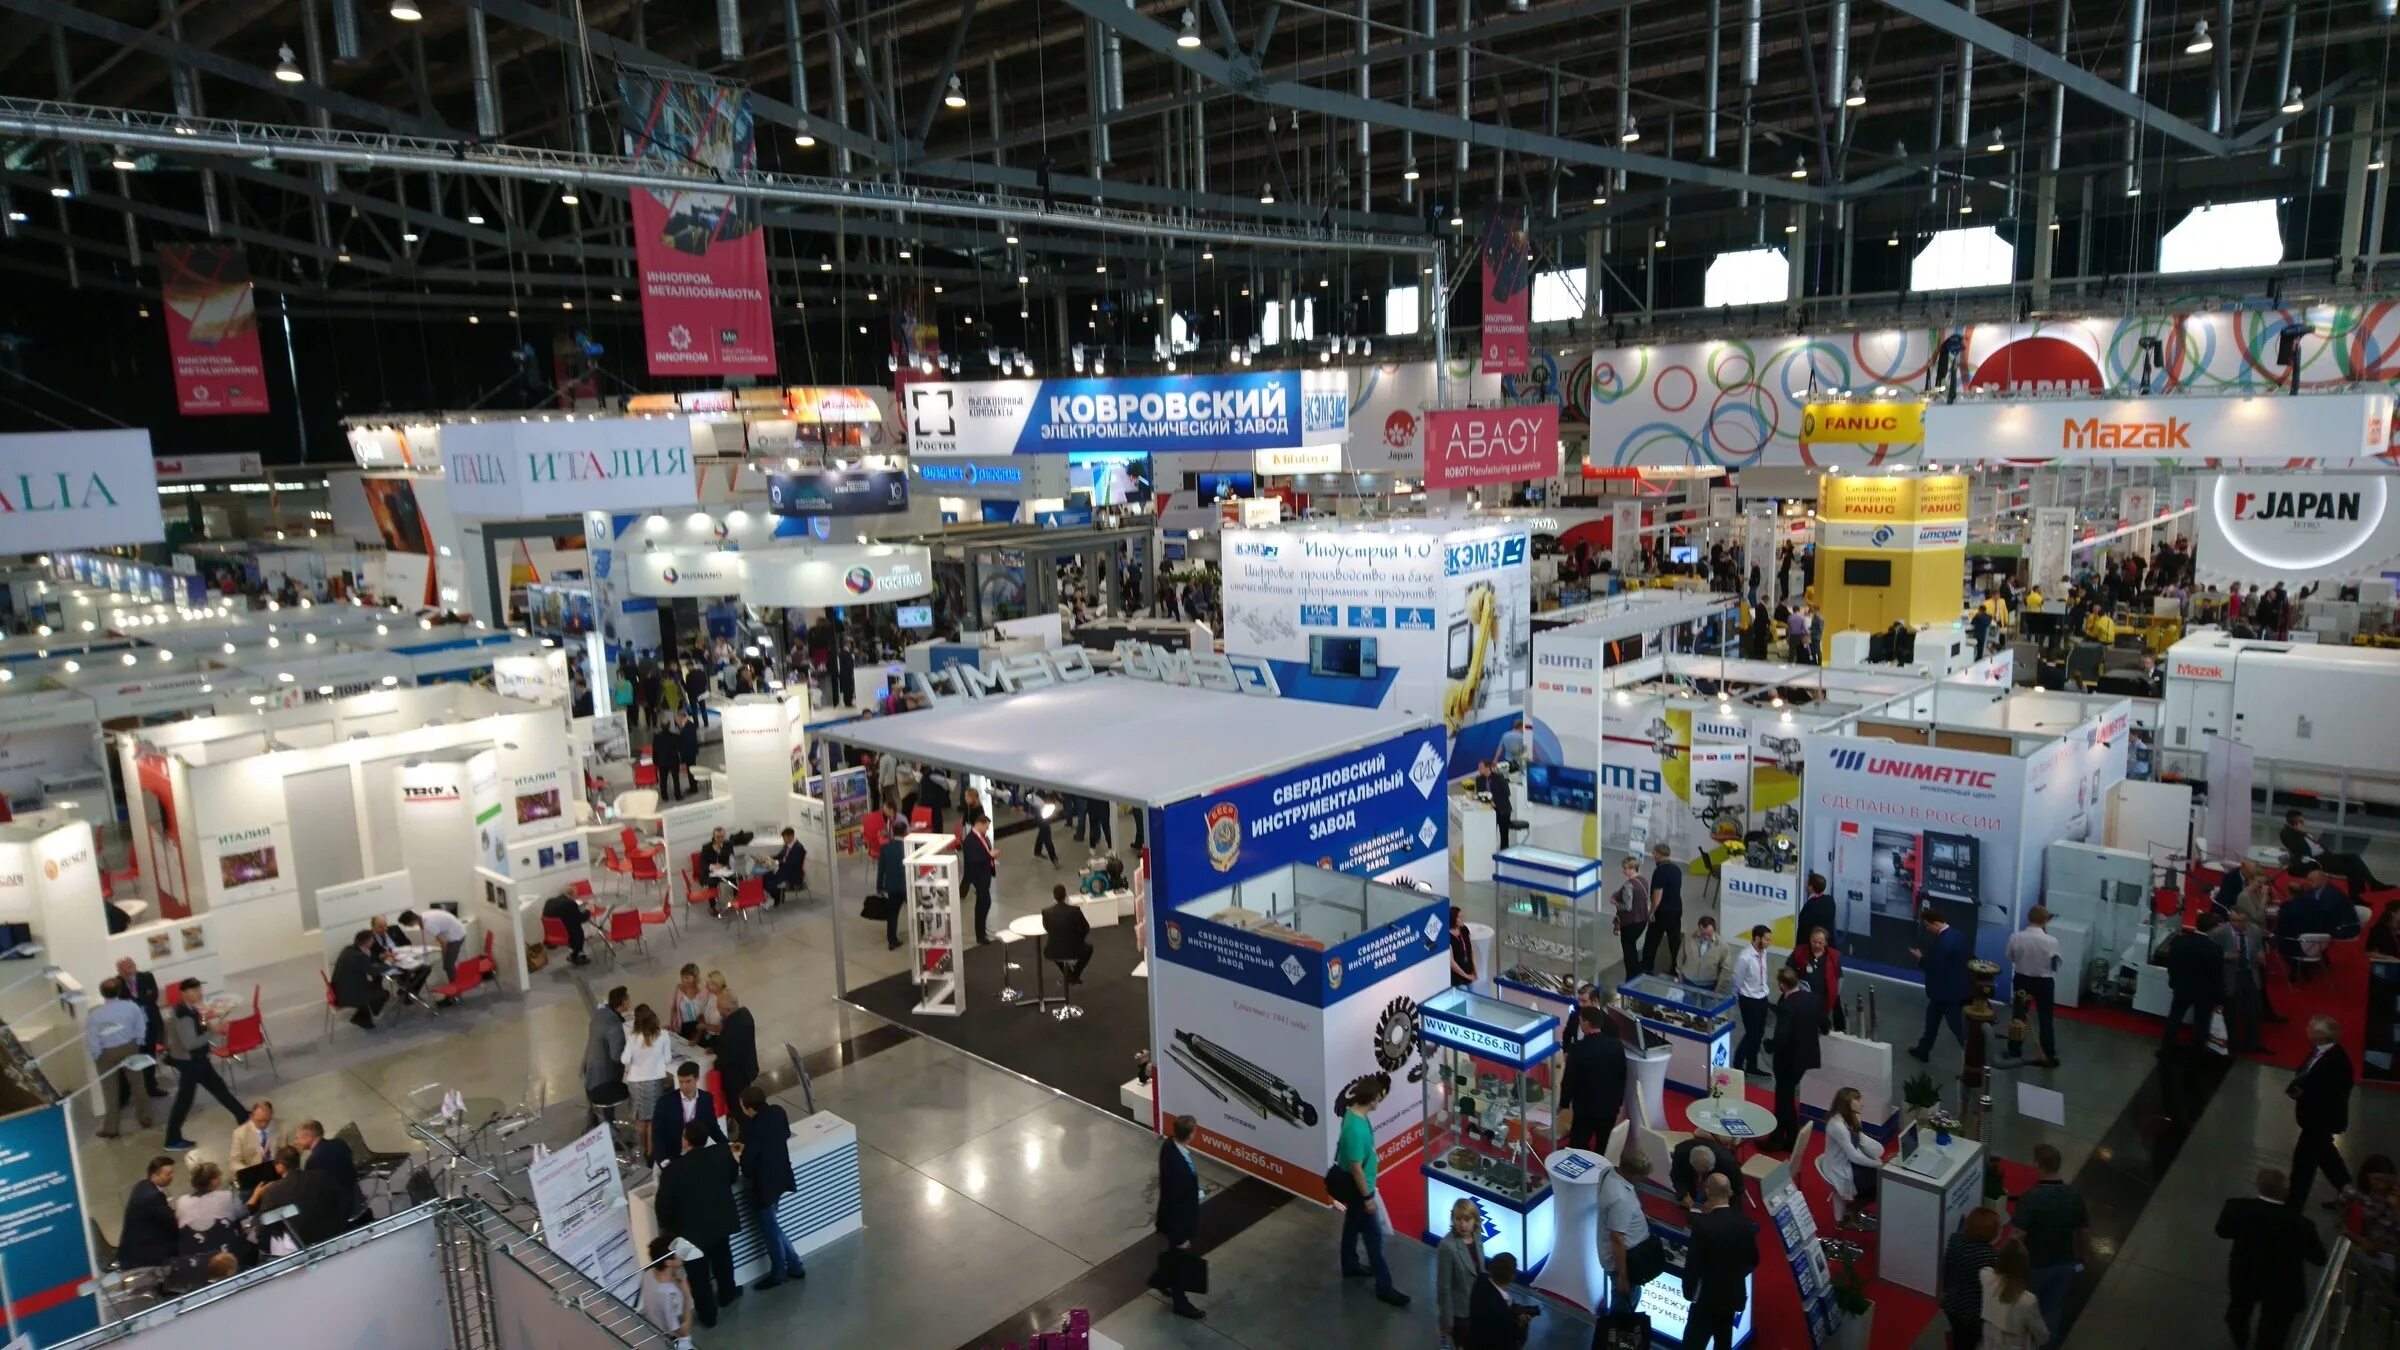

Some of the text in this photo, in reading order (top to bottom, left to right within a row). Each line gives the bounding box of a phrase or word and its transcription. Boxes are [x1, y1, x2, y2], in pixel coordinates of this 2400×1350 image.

[648, 285, 762, 300] МЕТАЛЛООБРАБОТКА
[655, 352, 709, 363] INNOPROM
[1050, 382, 1287, 424] КОВРОВСКИЙ
[1041, 418, 1289, 440] ЭЛЕКТРОМЕХАНИЧЕСКИЙ ЗАВОД
[1825, 417, 1897, 431] FANUC
[2062, 416, 2191, 450] Mazak
[916, 441, 956, 451] Ростех
[1445, 418, 1543, 460] ABAGY
[452, 453, 505, 485] ITALIA
[528, 447, 688, 483] ИТАЛИЯ
[1388, 451, 1413, 462] Japan
[1445, 466, 1469, 479] ROBOT
[1470, 464, 1510, 477] Manufacturing
[1845, 505, 1896, 514] FANUC
[1920, 503, 1962, 513] FANUC
[2256, 491, 2361, 521] JAPAN
[1450, 541, 1501, 569] КЭМЗ
[681, 571, 722, 580] RUSNANO
[1299, 567, 1386, 587] производство
[1538, 653, 1593, 670] auma
[2176, 663, 2223, 679] Mazak
[1696, 721, 1748, 739] auma
[515, 771, 556, 787] ИТАЛИЯ
[1273, 753, 1387, 806] СВЕРДЛОВСКИЙ
[1867, 757, 1996, 790] UNIMATIC
[1251, 768, 1404, 838] ИНСТРУМЕНТАЛЬНЫЙ
[1822, 794, 2001, 831] СДЕЛАНО В РОССИИ
[218, 826, 271, 846] ИТАЛИЯ
[1309, 809, 1357, 841] ЗАВОД
[1339, 834, 1414, 872] ИНСТРУМЕНТАЛЬНЫЙ
[1349, 827, 1405, 857] СВЕРДЛОВСКИЙ
[1366, 855, 1390, 873] ЗАВОД
[1728, 877, 1788, 900] auma
[1187, 936, 1275, 969] ИНСТРУМЕНТАЛЬНЫЙ
[1198, 931, 1262, 956] СВЕРДЛОВСКИЙ
[1348, 930, 1420, 972] ИНСТРУМЕНТАЛЬНЫЙ
[1358, 924, 1411, 956] СВЕРДЛОВСКИЙ
[1216, 954, 1244, 971] ЗАВОД
[1373, 953, 1397, 970] ЗАВОД
[1425, 1018, 1520, 1055] WWW.SIZ66.RU
[1201, 1133, 1284, 1175] www.siz66.ru
[1640, 1299, 1689, 1324] СТРУМЕН
